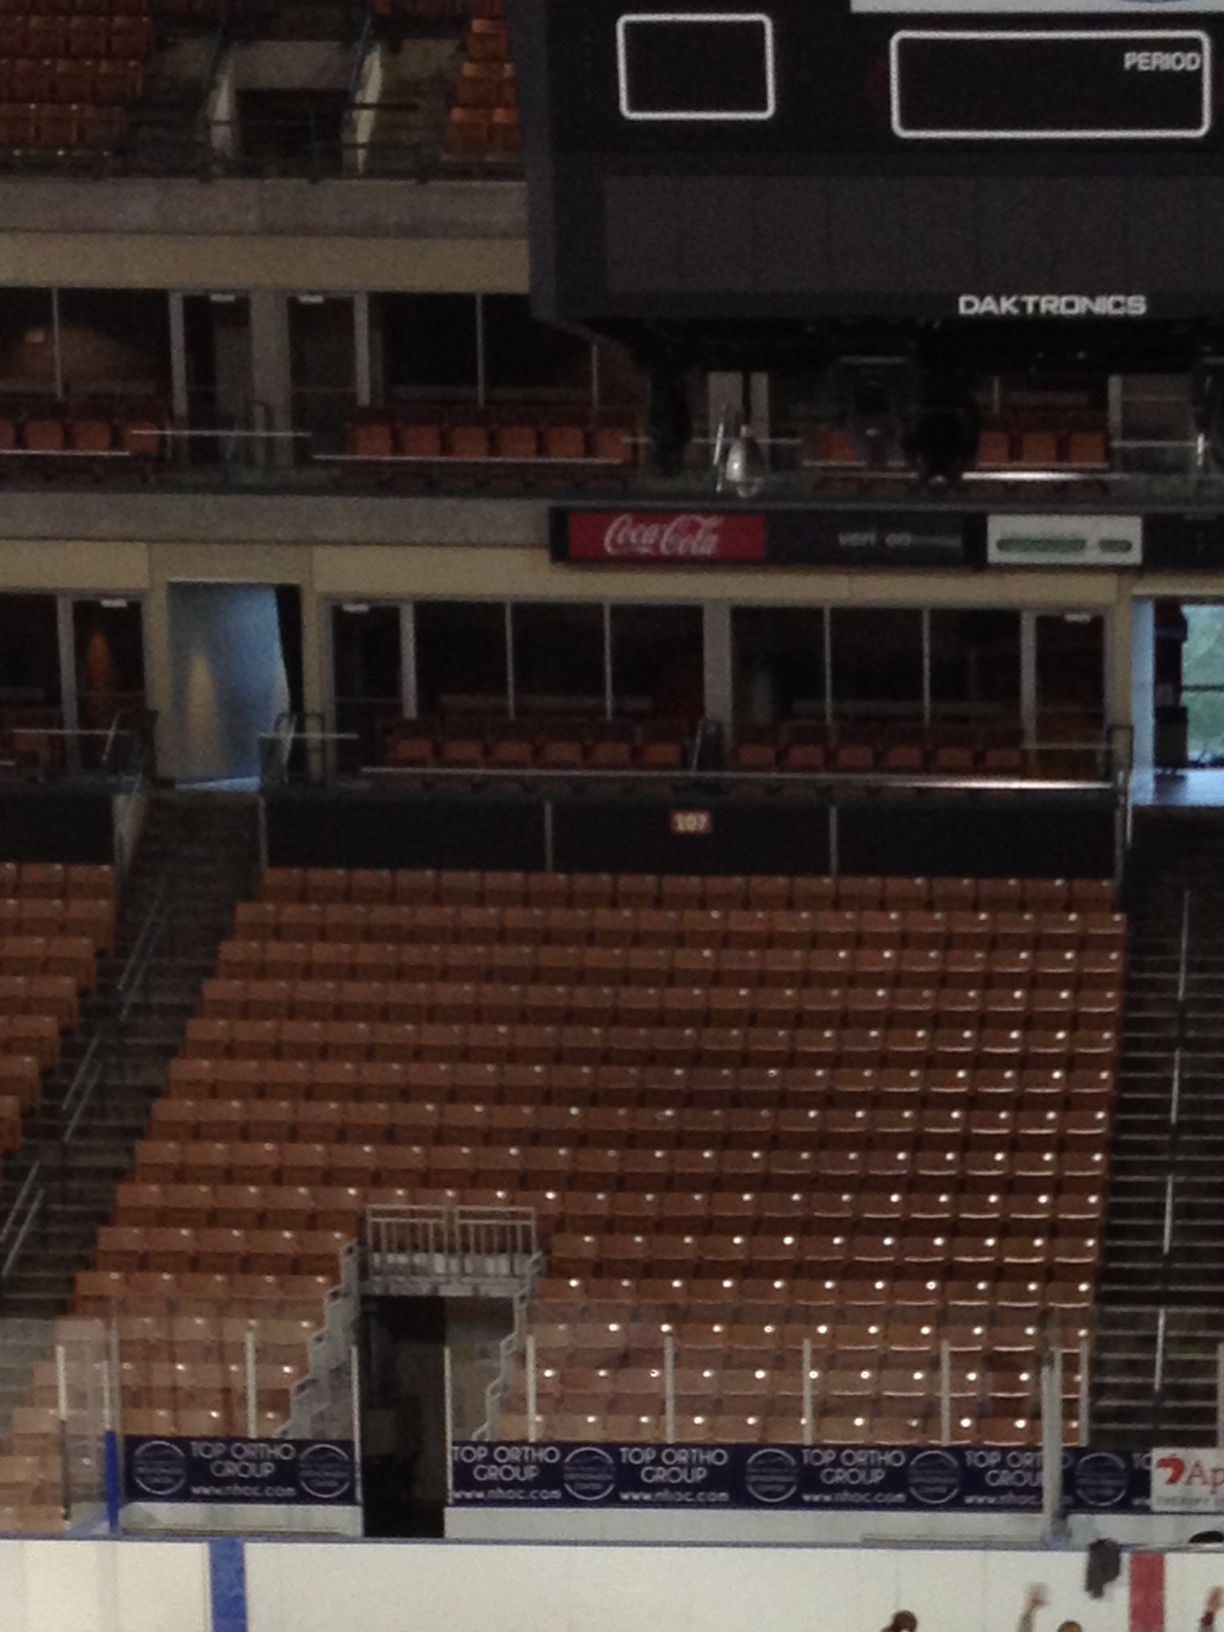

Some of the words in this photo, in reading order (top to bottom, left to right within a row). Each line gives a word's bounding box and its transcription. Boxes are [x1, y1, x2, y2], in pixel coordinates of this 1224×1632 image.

[1123, 52, 1201, 71] PERIOD
[958, 295, 1147, 316] DAKTRONICS
[191, 1441, 226, 1458] TOP
[230, 1442, 296, 1460] ORTHO
[452, 1446, 488, 1463] TOP
[493, 1446, 561, 1463] ORTHO
[619, 1448, 656, 1465] TOP
[661, 1448, 728, 1466] ORTHO
[802, 1449, 836, 1466] TOP
[840, 1450, 906, 1467] ORTHO
[965, 1451, 1000, 1468] TOP
[1006, 1451, 1073, 1469] ORTO
[210, 1461, 275, 1478] GROUP
[473, 1465, 540, 1482] GROUP
[640, 1467, 708, 1483] GROUP
[820, 1468, 886, 1485] GROUP
[985, 1470, 1043, 1486] GROU
